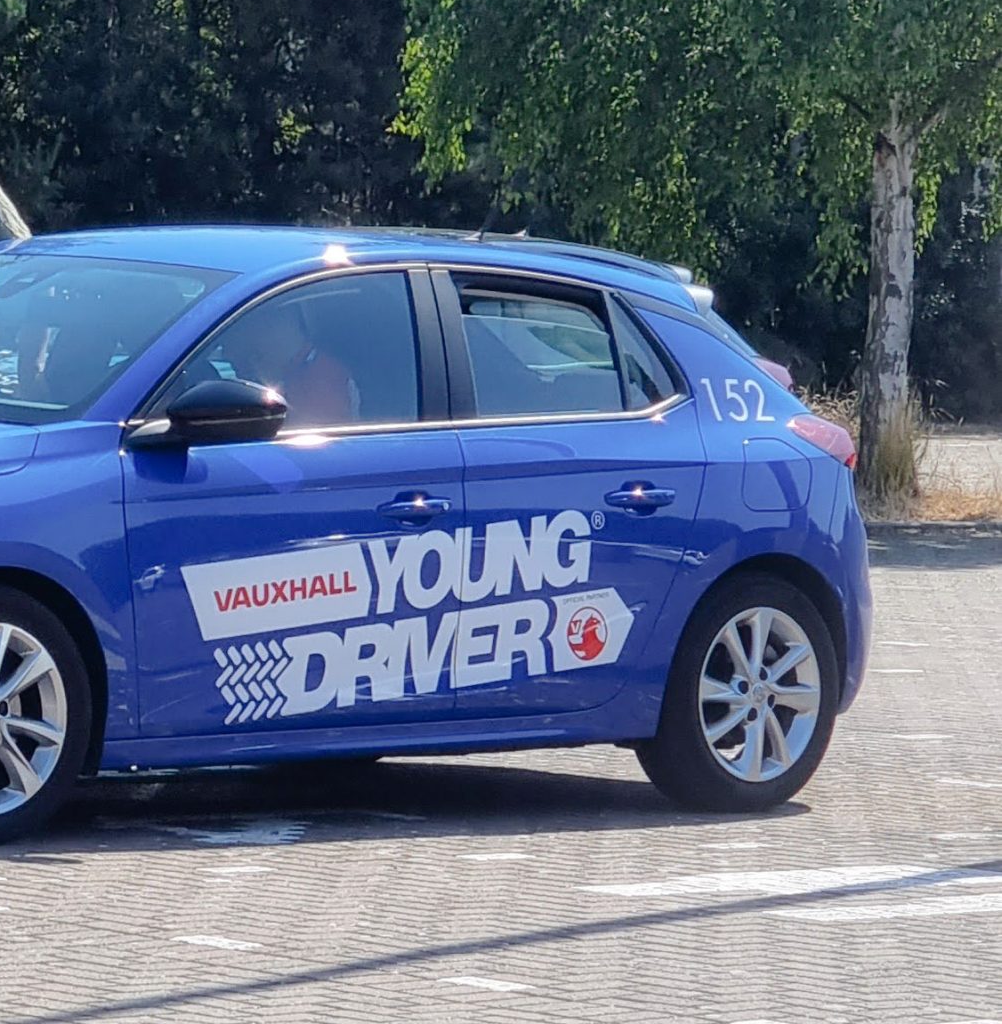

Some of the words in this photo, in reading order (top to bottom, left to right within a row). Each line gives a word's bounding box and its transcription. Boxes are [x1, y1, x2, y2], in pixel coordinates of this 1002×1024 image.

[700, 378, 776, 422] 152
[213, 570, 358, 614] VAUXHALL
[279, 598, 550, 717] DRIVER
